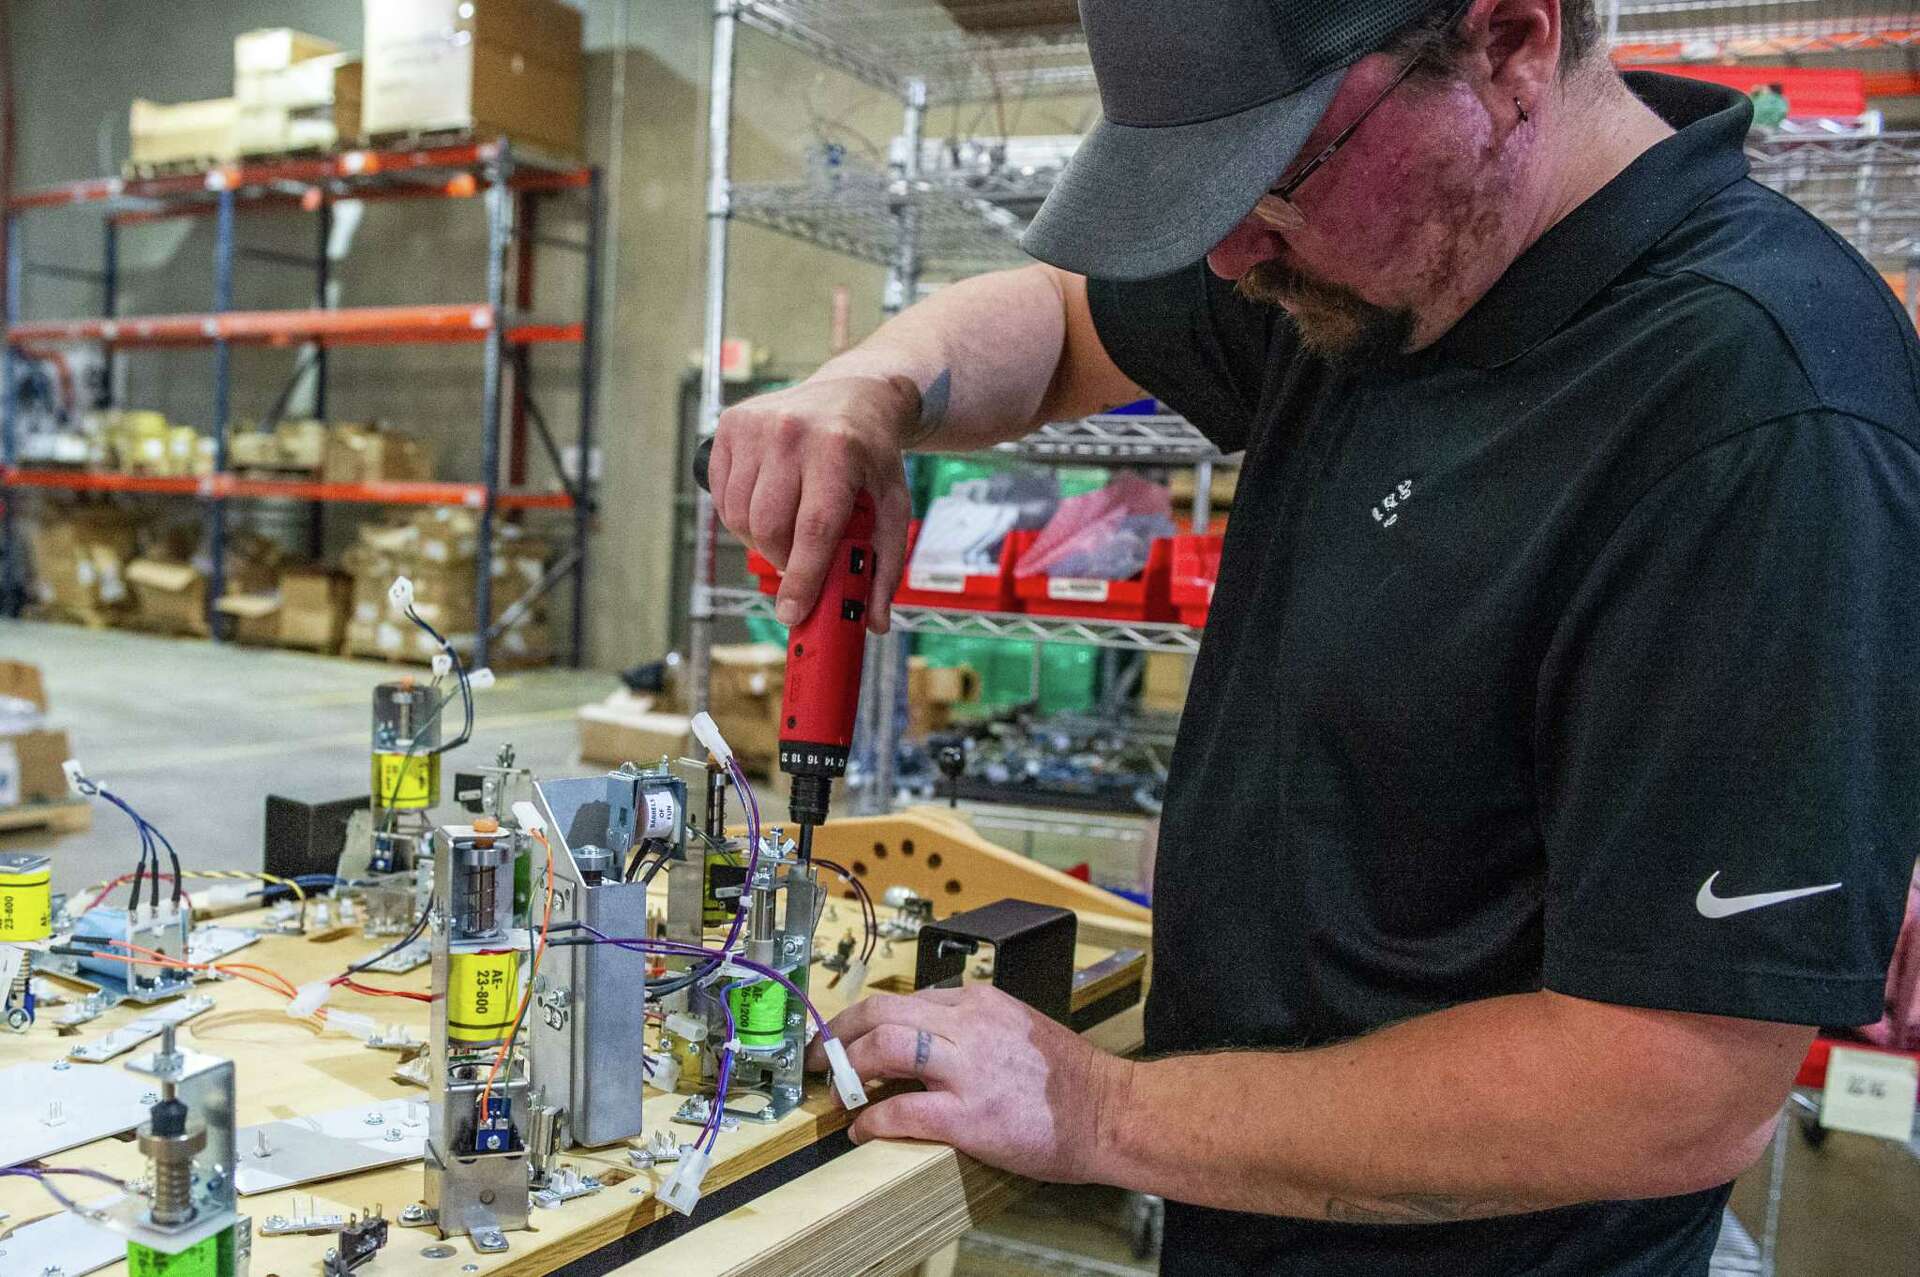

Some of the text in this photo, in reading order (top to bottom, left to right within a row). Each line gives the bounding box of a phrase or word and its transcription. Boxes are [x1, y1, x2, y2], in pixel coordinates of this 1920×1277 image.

[791, 752, 801, 763] 18
[807, 754, 819, 765] 16
[824, 756, 834, 766] 14
[659, 808, 665, 818] OF
[491, 969, 503, 990] AE-
[475, 970, 490, 1015] 23-800
